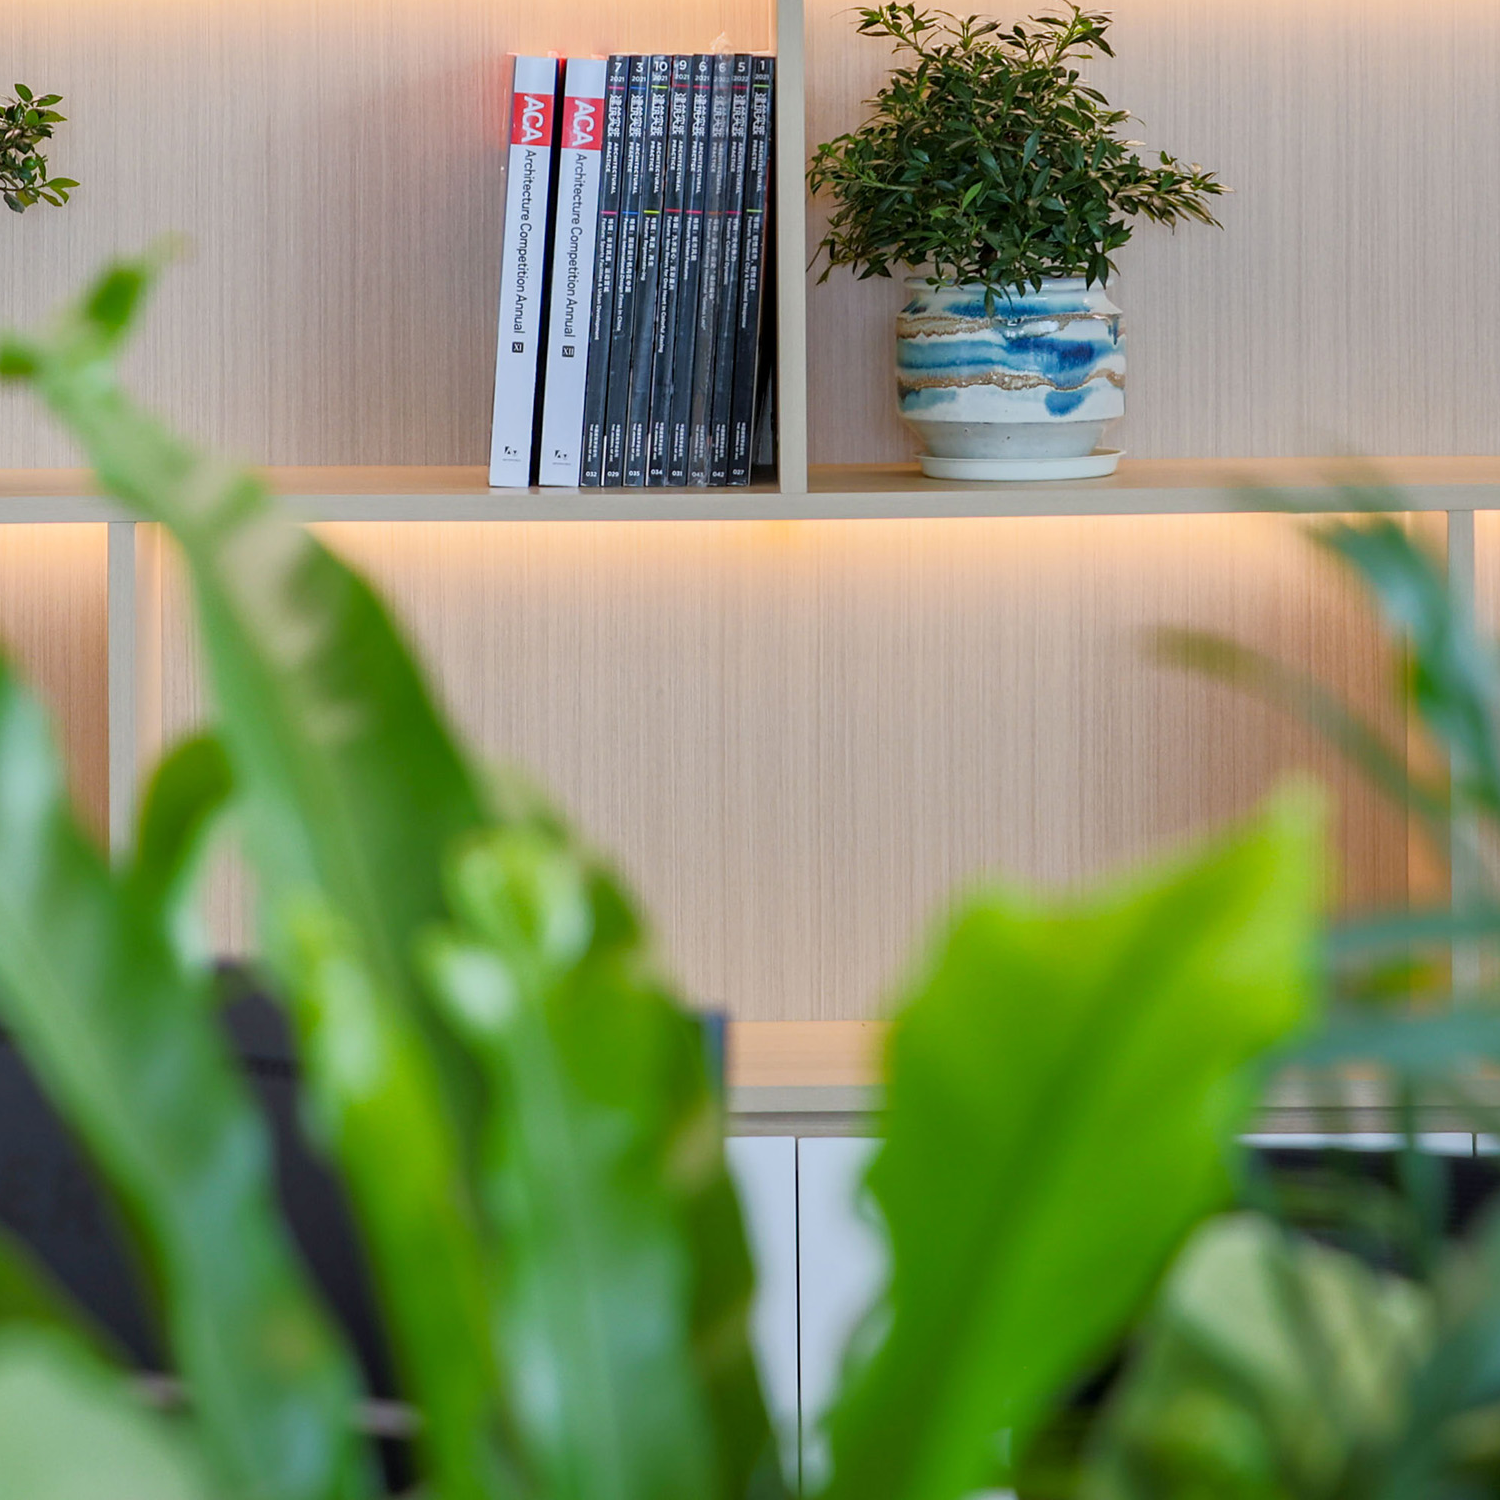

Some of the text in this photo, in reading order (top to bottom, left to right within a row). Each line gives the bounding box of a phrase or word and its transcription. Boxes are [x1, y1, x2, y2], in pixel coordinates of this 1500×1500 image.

[614, 62, 622, 72] 7
[636, 62, 644, 73] 3
[654, 61, 668, 72] 10
[679, 60, 687, 70] 9
[699, 61, 707, 72] 6
[719, 62, 726, 73] 6
[737, 62, 746, 72] 5
[760, 60, 765, 70] 1
[521, 96, 545, 143] ACA
[572, 100, 596, 146] ACA
[611, 142, 619, 194] ARCHITECTURAL
[632, 142, 640, 194] ARCHITECTURAL
[654, 141, 662, 194] ARCHITECTURAL
[675, 140, 683, 192] ARCHITECTURAL
[696, 142, 704, 194] ARCHITECTURAL
[756, 140, 764, 192] ARCHITECTURAL
[513, 149, 536, 352] Architecture Competition Annual XI
[563, 153, 587, 356] Architecture Competition Annual XII
